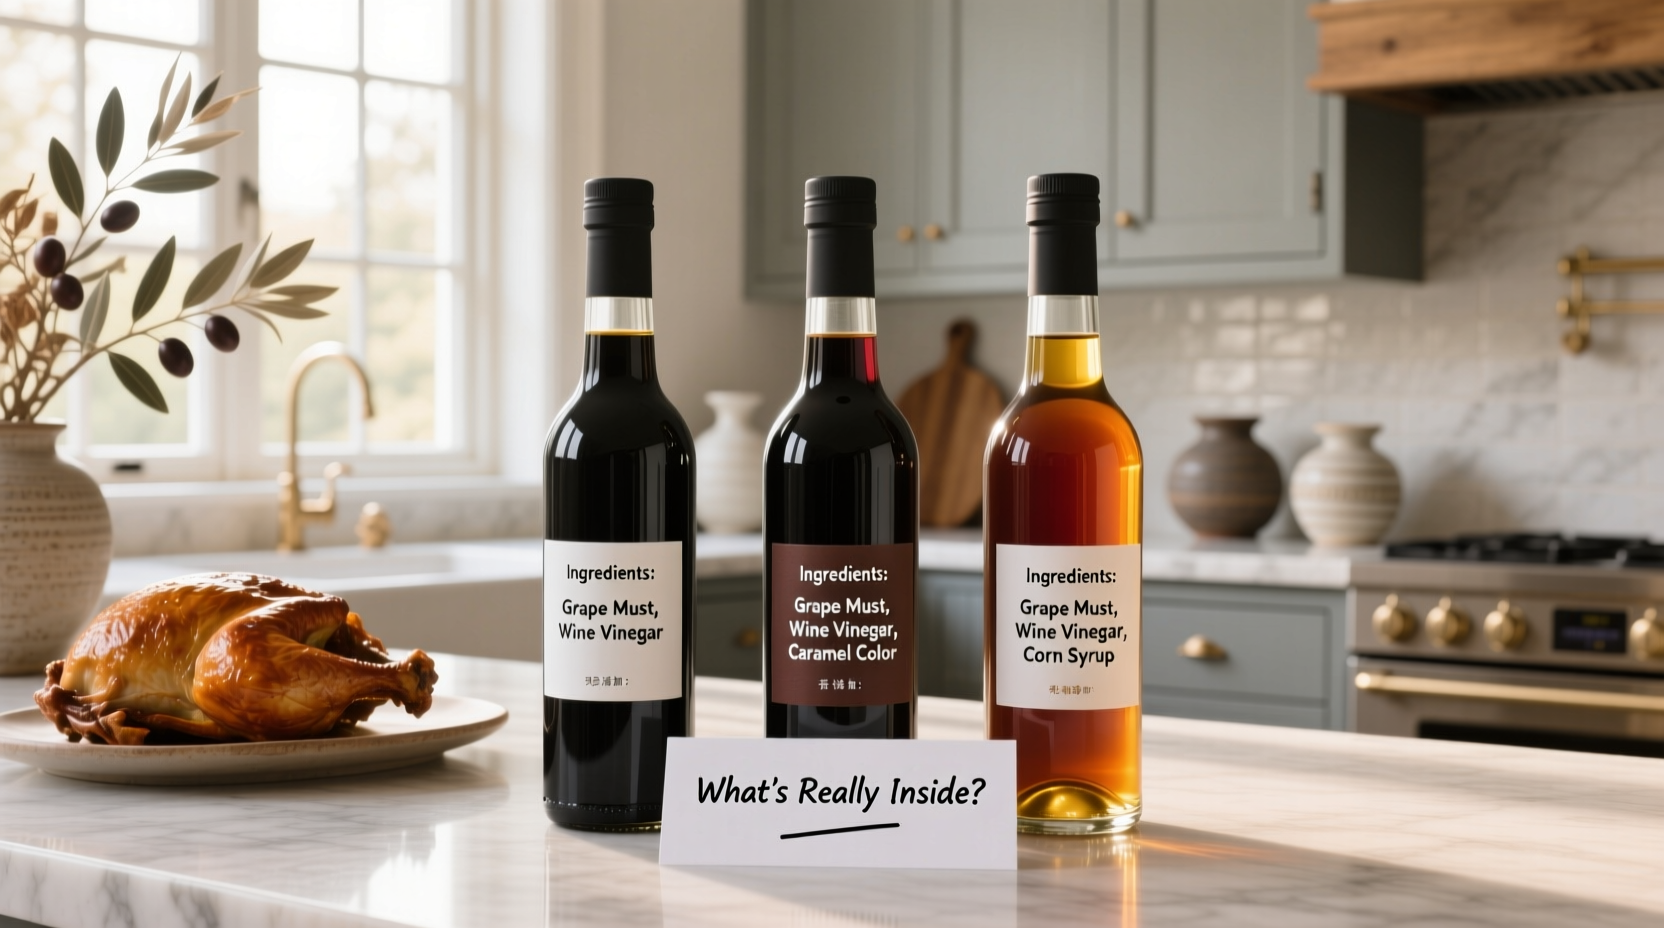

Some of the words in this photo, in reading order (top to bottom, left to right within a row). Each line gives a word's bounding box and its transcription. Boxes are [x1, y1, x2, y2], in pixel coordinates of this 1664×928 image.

[567, 564, 655, 584] Ingredients:
[800, 565, 888, 586] Ingredients:
[1026, 567, 1117, 587] Ingredients:
[562, 599, 608, 620] Grape
[613, 600, 659, 619] Must,
[794, 597, 841, 618] Grape
[846, 597, 890, 616] Must,
[1020, 599, 1069, 621] Grape
[1074, 600, 1118, 618] Must,
[558, 623, 596, 640] Wine
[600, 624, 664, 645] Vinegar
[789, 620, 830, 638] Wine
[833, 620, 898, 642] Vinegar,
[1015, 622, 1057, 639] Wine
[1061, 623, 1127, 643] Vinegar,
[788, 643, 852, 661] Caramel
[856, 644, 897, 661] Color
[1023, 646, 1063, 663] Corn
[1067, 647, 1115, 668] Syrup
[698, 775, 789, 803] What's
[798, 775, 880, 813] Really
[890, 775, 987, 805] Inside?
